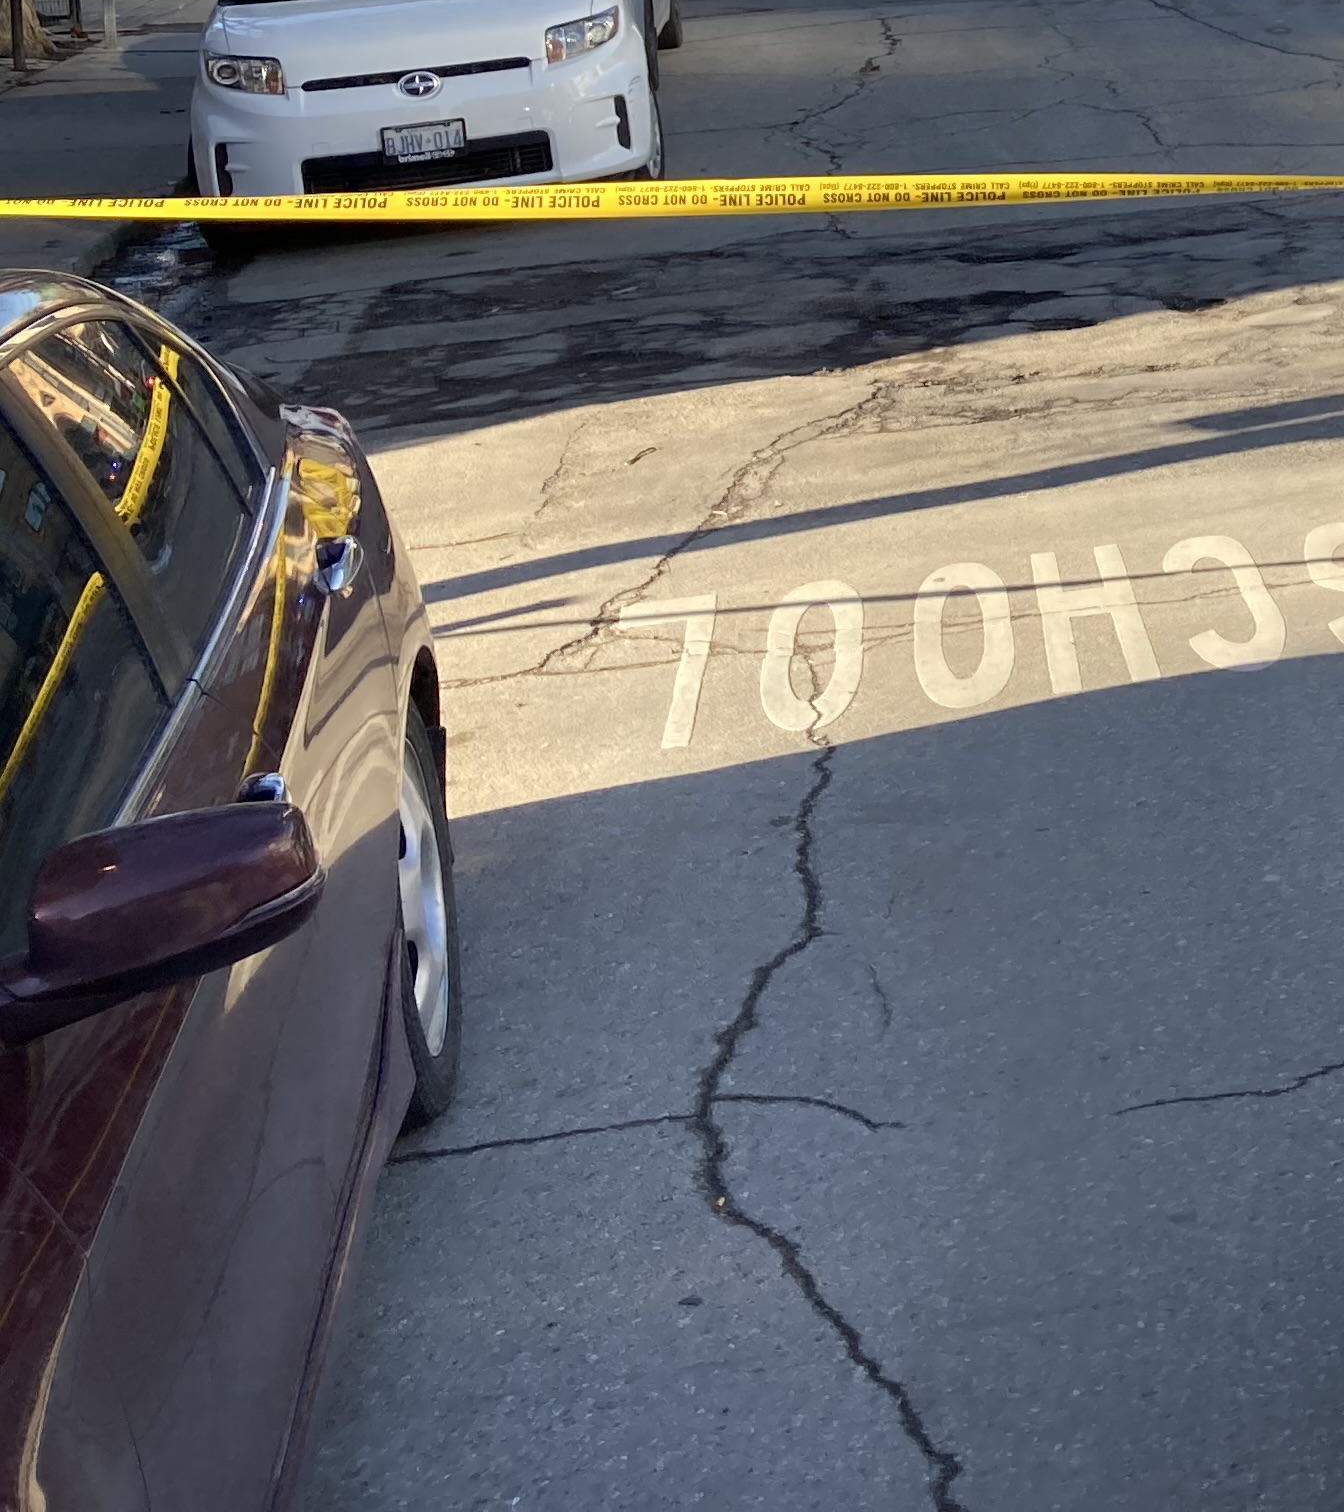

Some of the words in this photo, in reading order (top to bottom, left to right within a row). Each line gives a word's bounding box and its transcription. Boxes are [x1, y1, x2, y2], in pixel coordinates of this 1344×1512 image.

[759, 184, 787, 192] CRIME
[790, 183, 810, 192] CALL
[961, 182, 987, 190] CRIME
[991, 182, 1010, 190] CALL
[554, 187, 581, 195] CRIME
[1023, 191, 1061, 199] CROSS
[1065, 190, 1087, 198] NOT
[1092, 190, 1108, 198] DO
[618, 195, 658, 206] CROSS
[663, 195, 686, 205] NOT
[691, 195, 708, 205] DO
[755, 193, 806, 206] POLICE
[823, 193, 862, 204] CROSS
[867, 193, 889, 203] NOT
[894, 193, 910, 202] DO
[957, 191, 1006, 202] POLICE
[107, 199, 165, 208] POLICE
[184, 198, 228, 207] CROSS
[232, 198, 259, 207] NOT
[263, 198, 281, 207] DO
[333, 197, 388, 208] POLICE
[406, 197, 448, 207] CROSS
[452, 197, 477, 206] NOT
[482, 197, 499, 206] DO
[549, 195, 600, 208] POLICE
